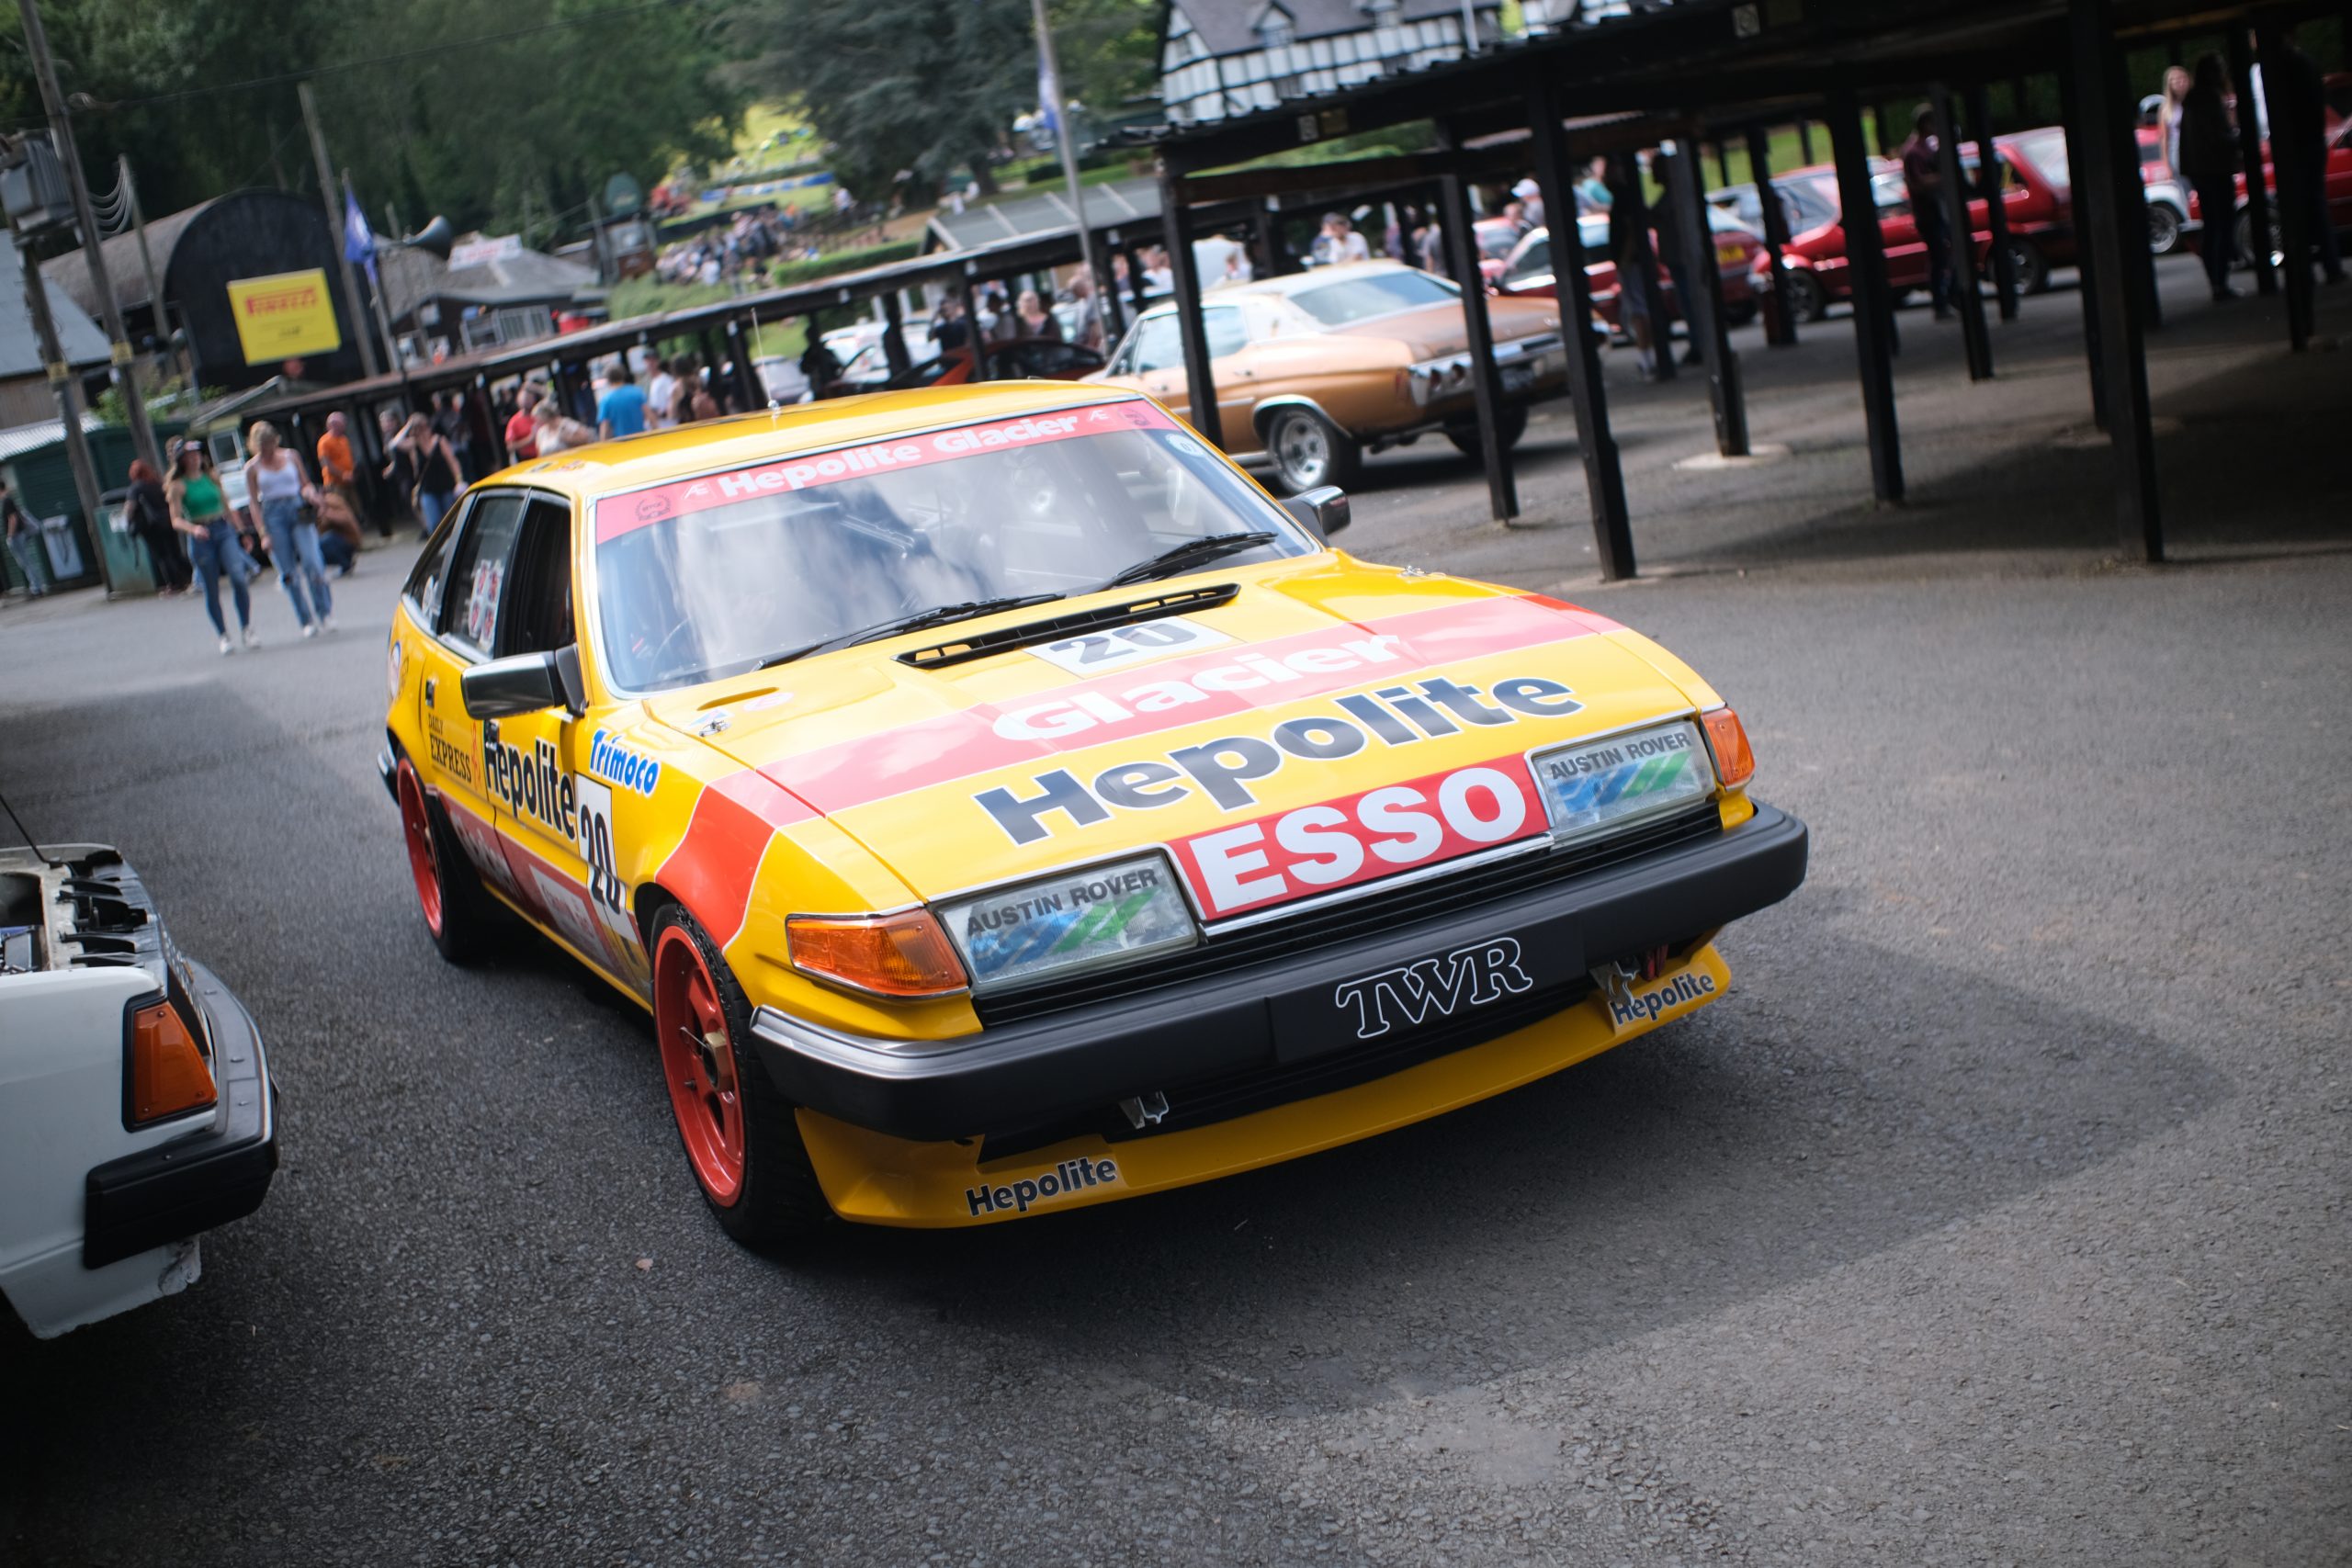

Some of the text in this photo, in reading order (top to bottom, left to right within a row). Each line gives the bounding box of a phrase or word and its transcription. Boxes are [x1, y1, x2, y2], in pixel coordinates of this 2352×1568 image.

[718, 444, 922, 498] Hepolite
[933, 413, 1079, 453] Glacier
[1048, 622, 1198, 665] 20
[992, 634, 1403, 740] Glacier
[428, 713, 445, 735] DAILY
[1550, 732, 1691, 780] AUSTIN ROVER
[429, 734, 472, 784] EXPRESS
[484, 720, 576, 841] Hepolite
[588, 728, 661, 795] Trimoco
[973, 675, 1587, 846] Hepolite
[581, 804, 621, 915] 20
[1189, 766, 1527, 913] ESSO
[967, 868, 1159, 937] AUSTIN ROVER
[1335, 937, 1533, 1039] TWR
[1610, 972, 1715, 1026] Hepolite
[966, 1156, 1117, 1217] Hepolite
